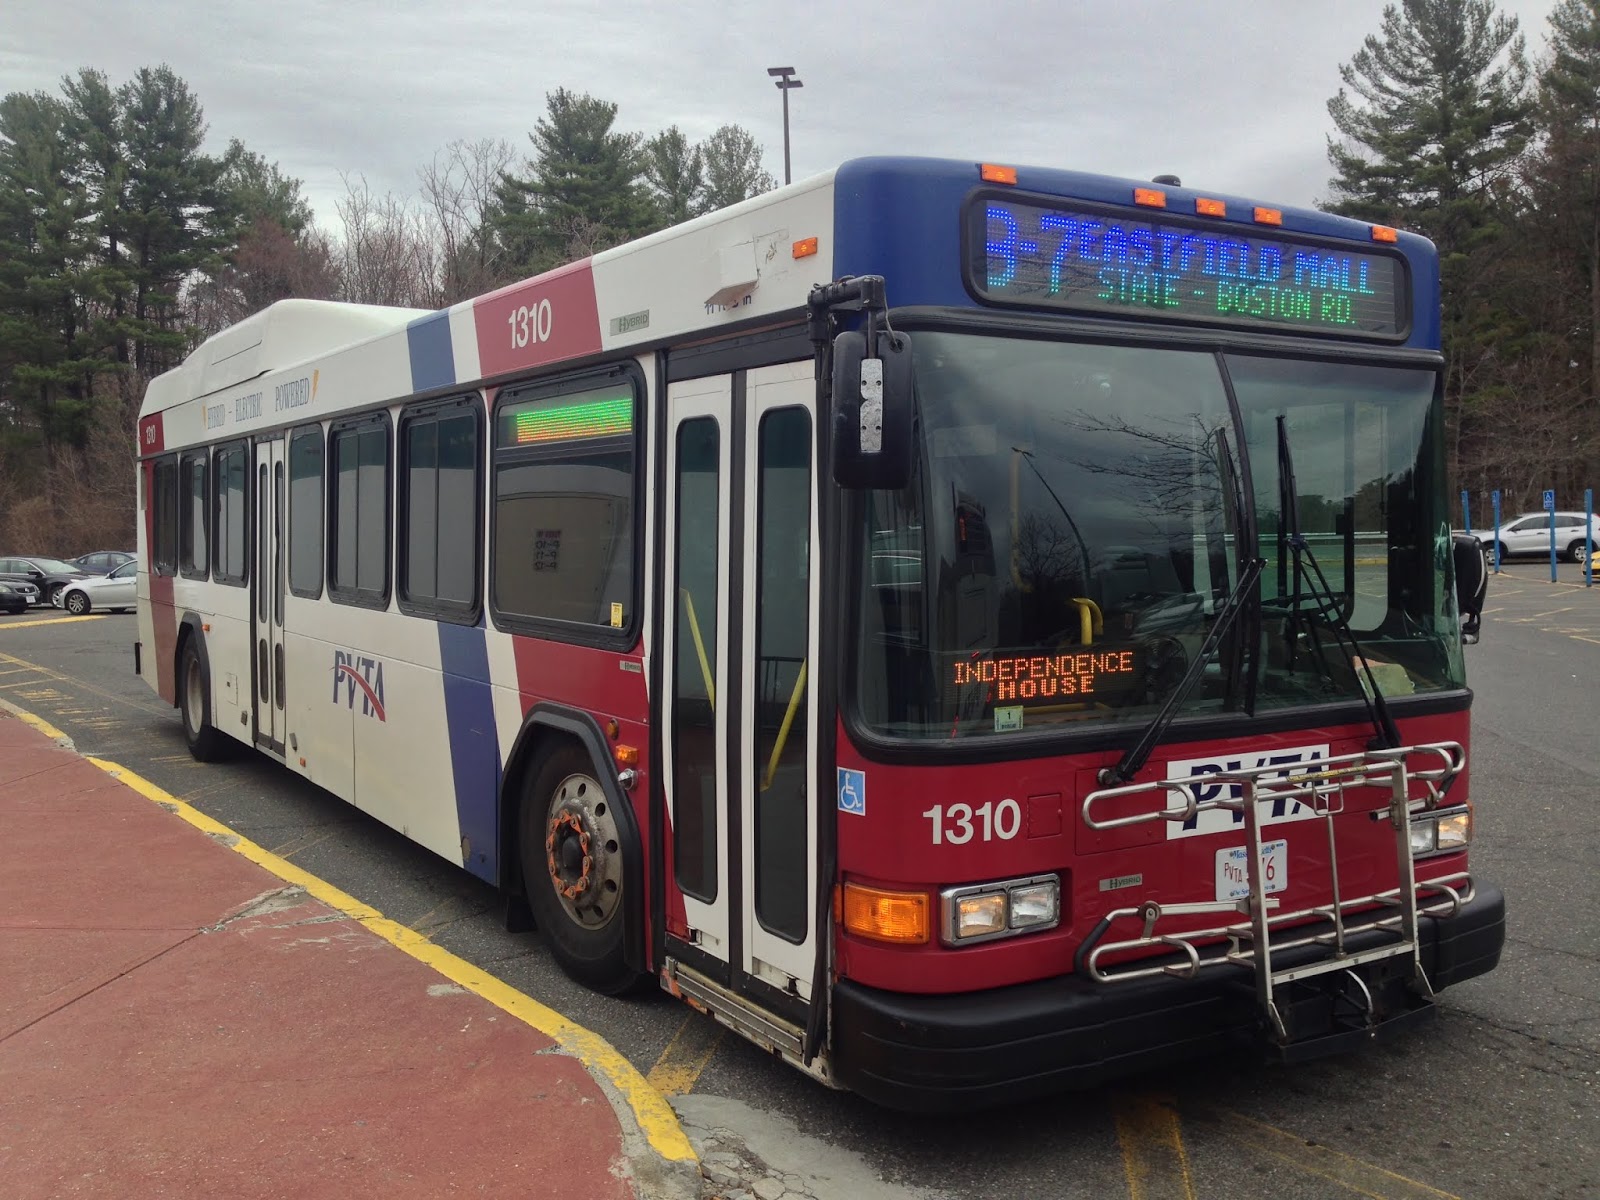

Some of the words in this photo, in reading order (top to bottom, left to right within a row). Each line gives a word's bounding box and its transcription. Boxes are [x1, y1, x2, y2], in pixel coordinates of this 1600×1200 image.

[1079, 222, 1281, 282] EASTFIELD
[1294, 251, 1376, 295] MALL
[1097, 266, 1181, 306] STATE
[1216, 280, 1311, 320] BOSTON
[1320, 292, 1357, 325] RD.
[507, 298, 552, 350] 1310
[274, 377, 310, 413] POWERED
[332, 650, 386, 720] PVTA
[953, 650, 1134, 684] INDEPENDENCE
[997, 675, 1095, 700] HOUSE
[1181, 750, 1327, 831] PVTA
[922, 797, 1022, 845] 1310
[1224, 862, 1243, 884] PVTA
